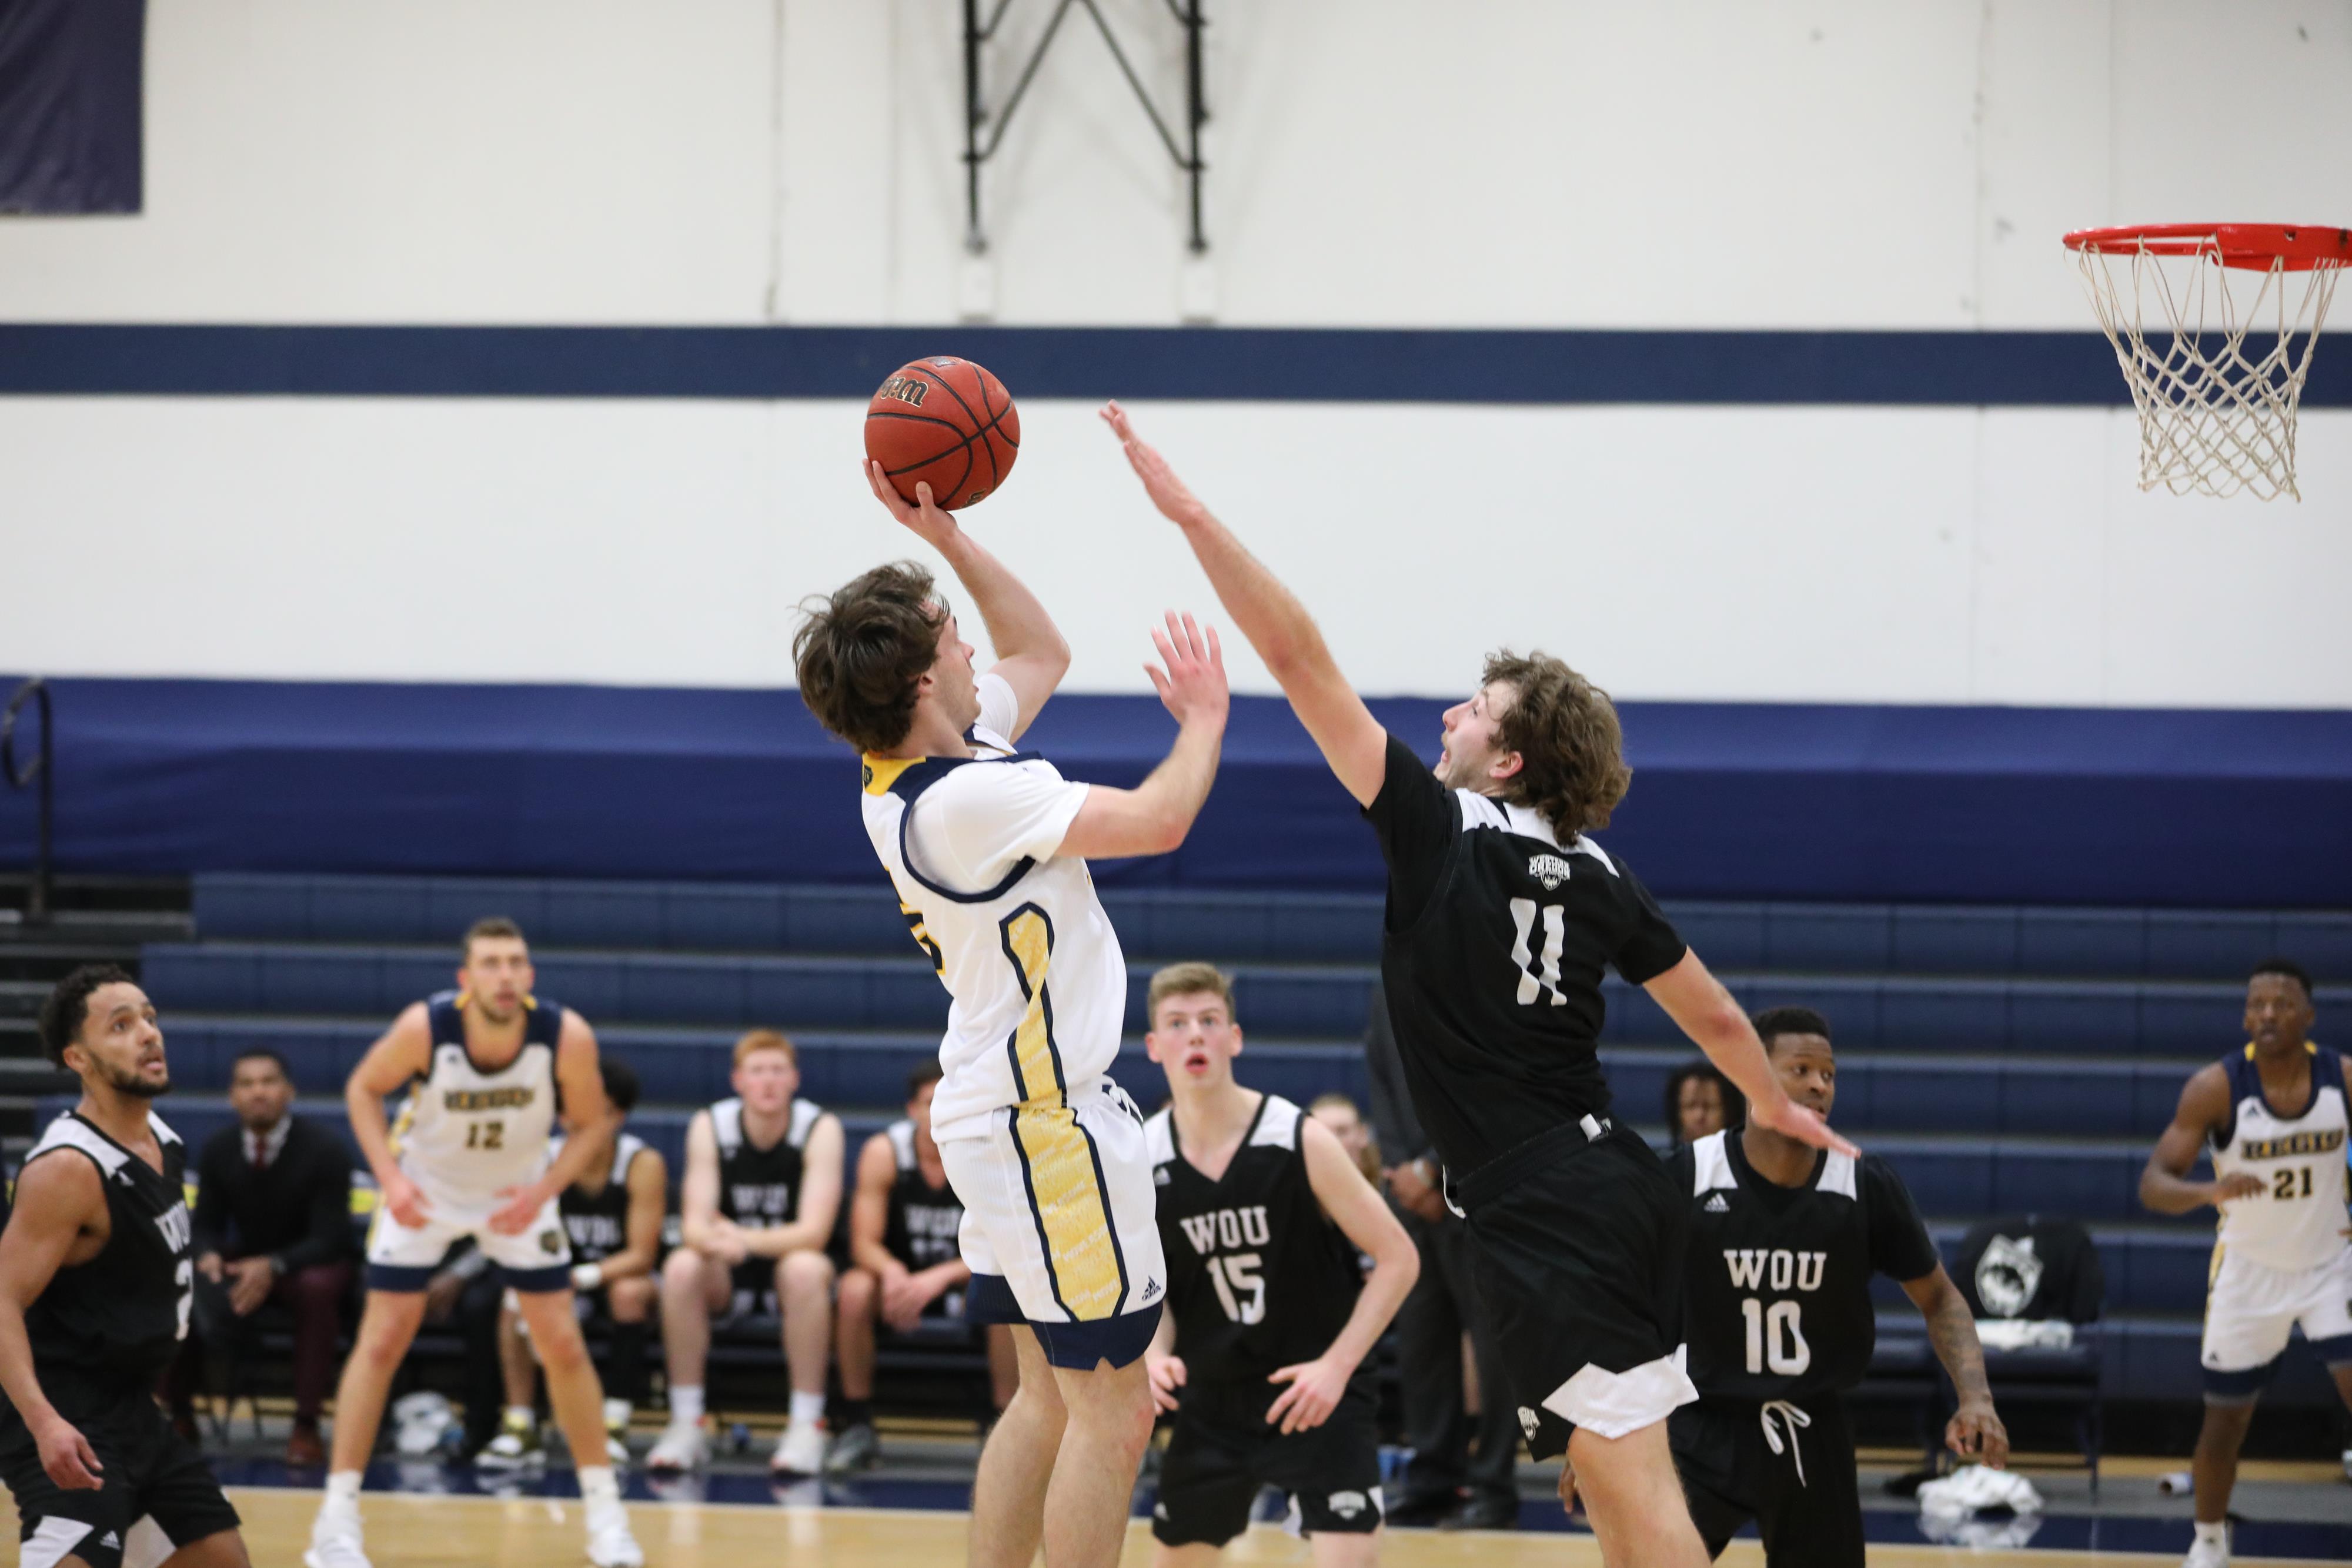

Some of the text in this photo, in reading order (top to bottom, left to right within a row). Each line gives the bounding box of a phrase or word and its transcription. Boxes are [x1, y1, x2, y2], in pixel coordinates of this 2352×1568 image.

[1509, 897, 1568, 1006] 11
[467, 1122, 503, 1149] 12
[2274, 1166, 2313, 1199] 21
[1180, 1205, 1270, 1254] WOU
[1207, 1253, 1265, 1325] 15
[1723, 1249, 1827, 1291] WOU
[1742, 1297, 1810, 1376] 10
